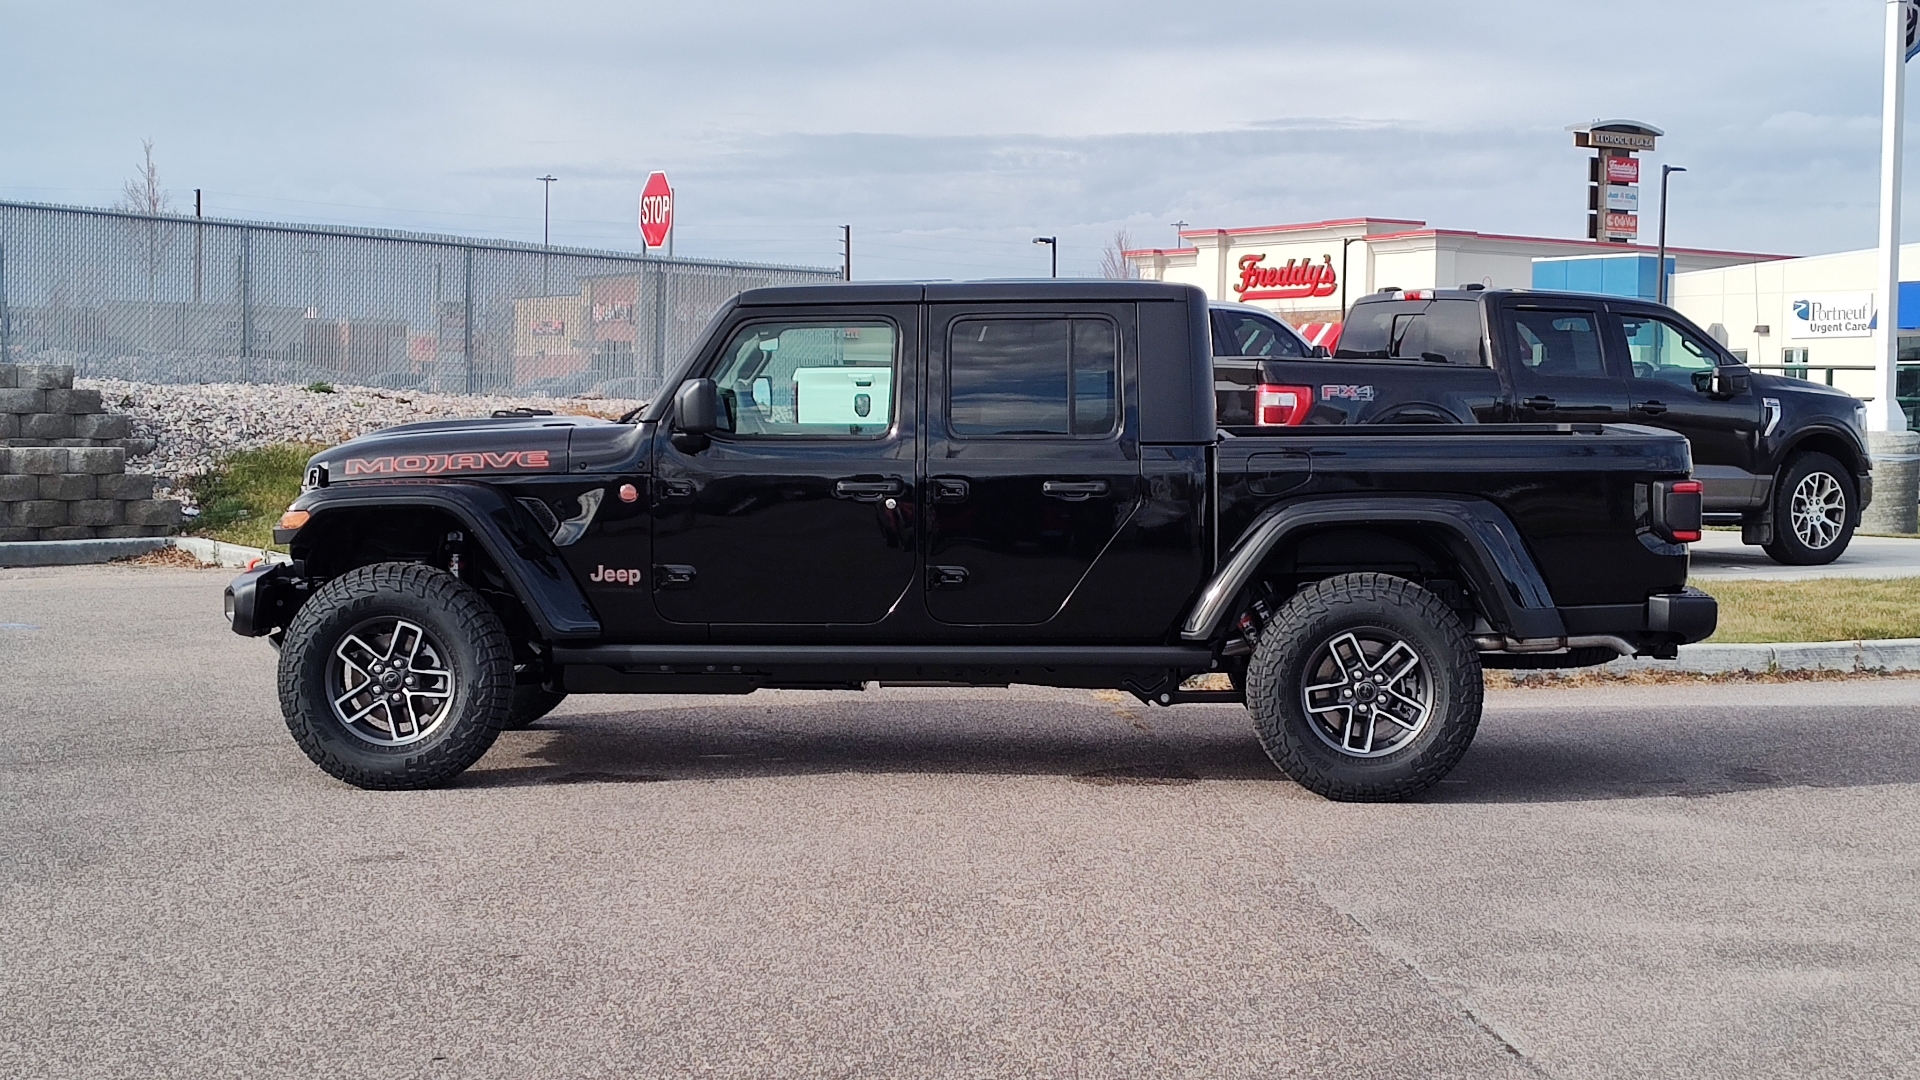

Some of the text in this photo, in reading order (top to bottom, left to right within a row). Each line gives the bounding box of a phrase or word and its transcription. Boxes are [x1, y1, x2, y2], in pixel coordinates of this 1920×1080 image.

[1595, 134, 1654, 148] BEDROCK PLAZA
[641, 195, 670, 225] STOP
[1233, 253, 1338, 302] Freddy's
[1811, 302, 1868, 321] Portneuf
[1810, 321, 1867, 333] Urgent Care
[1321, 384, 1375, 402] FX4
[345, 450, 549, 475] MOJAVE
[590, 564, 641, 585] Jeep
